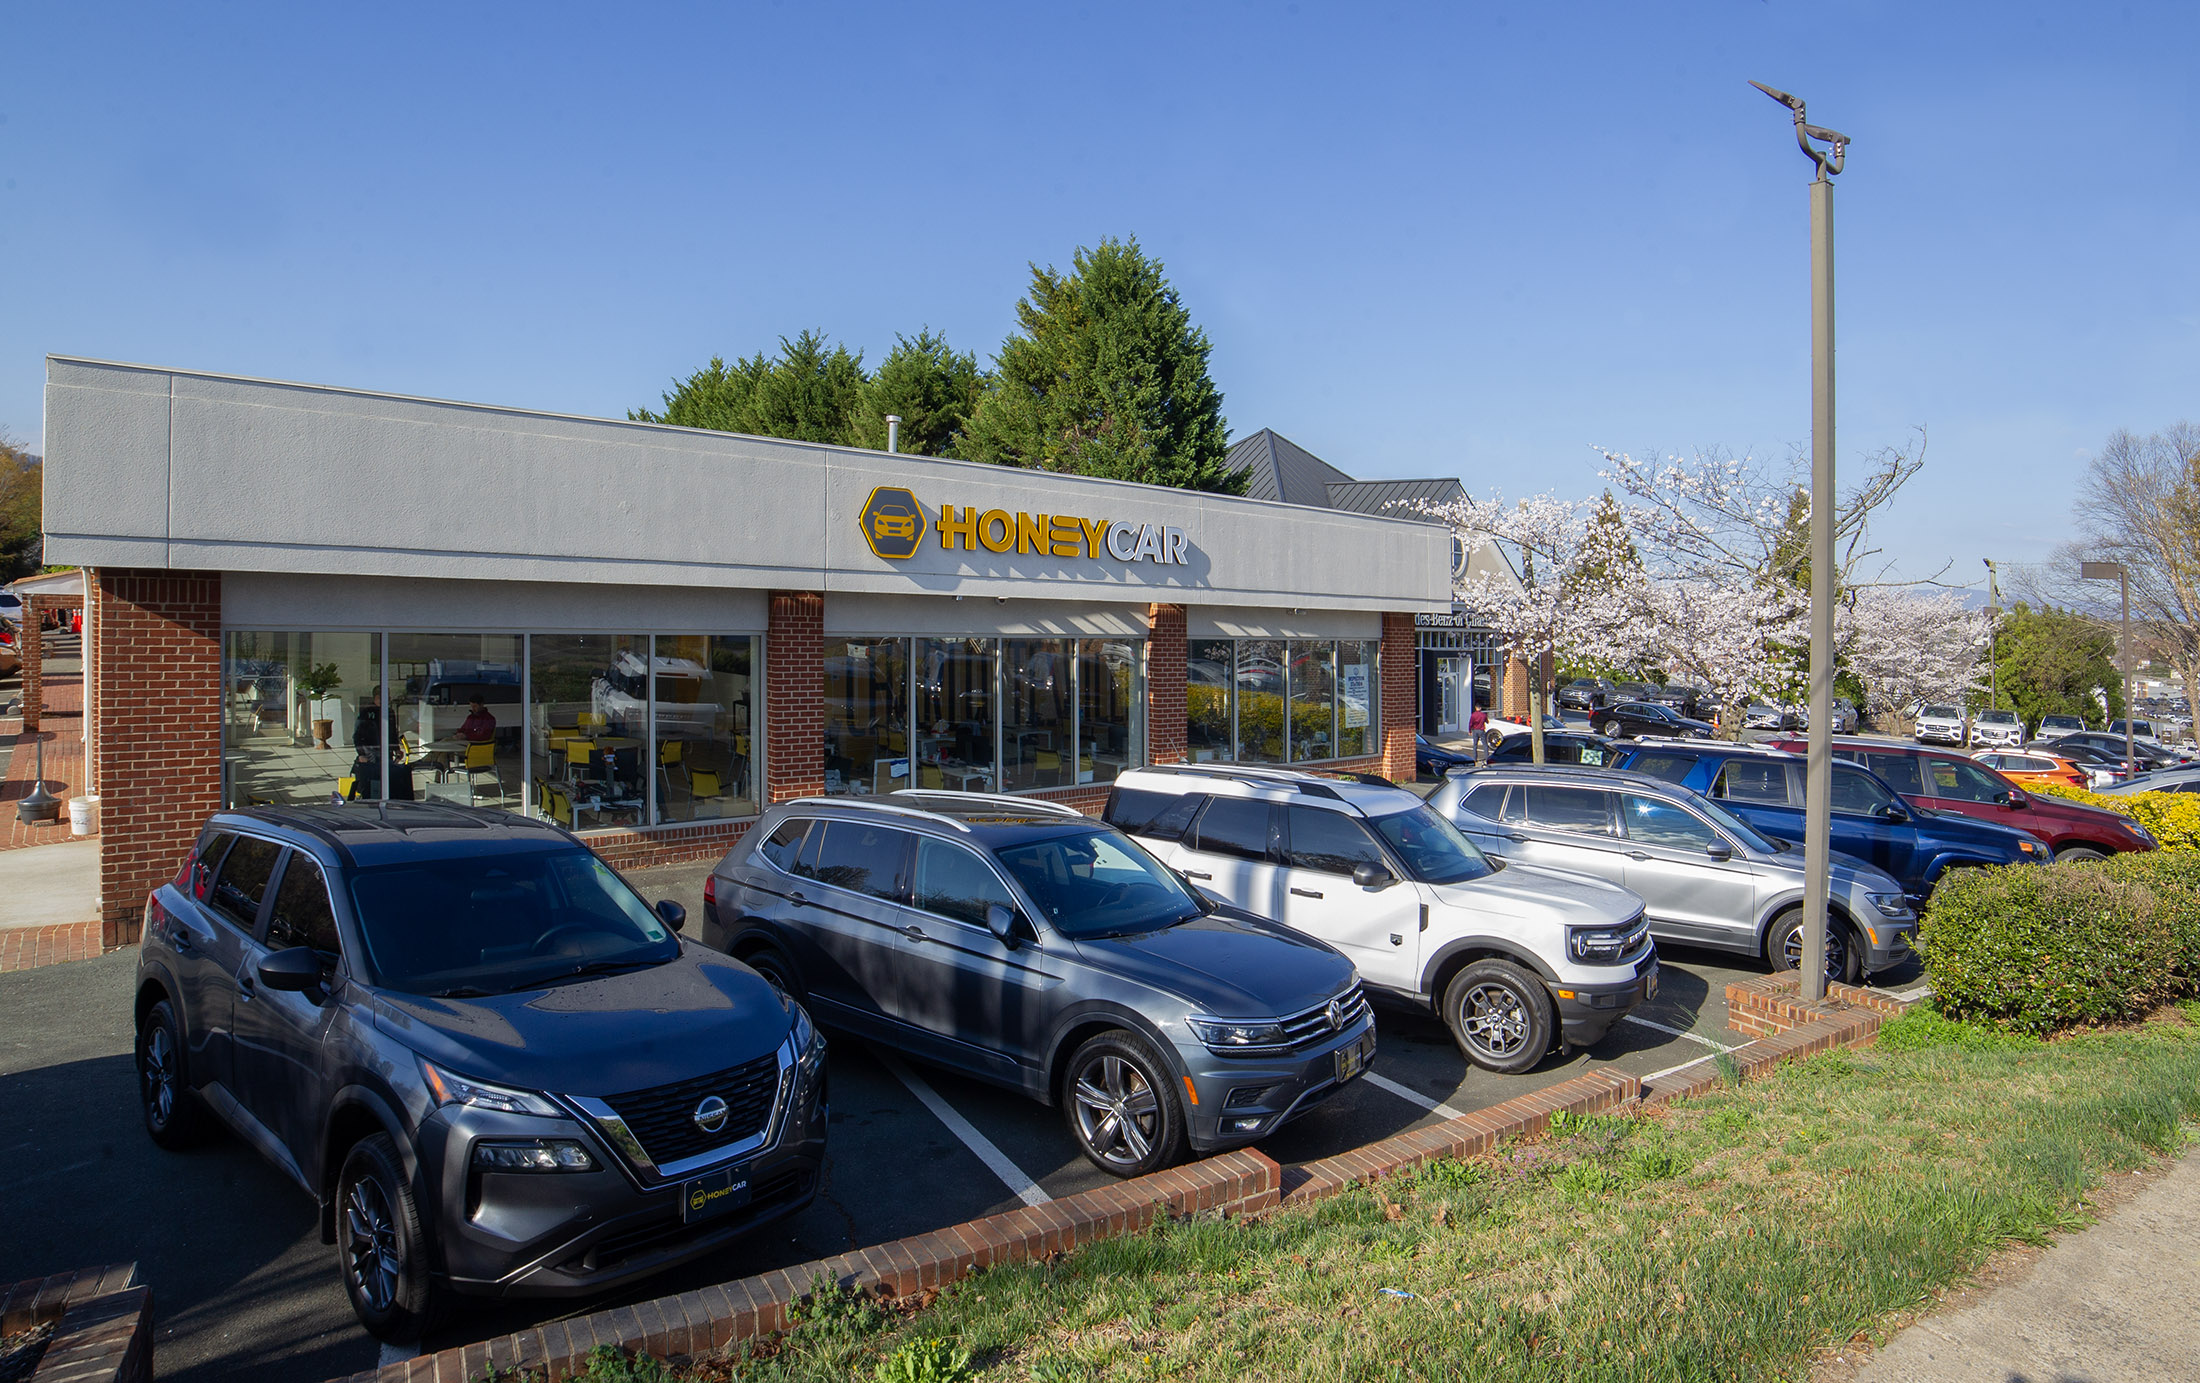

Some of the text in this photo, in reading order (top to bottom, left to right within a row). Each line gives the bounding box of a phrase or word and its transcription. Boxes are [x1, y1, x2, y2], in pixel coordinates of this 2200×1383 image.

[935, 504, 1189, 566] HONEYCAR
[700, 1108, 726, 1121] NISSAN
[706, 1180, 747, 1200] HONEYCAR
